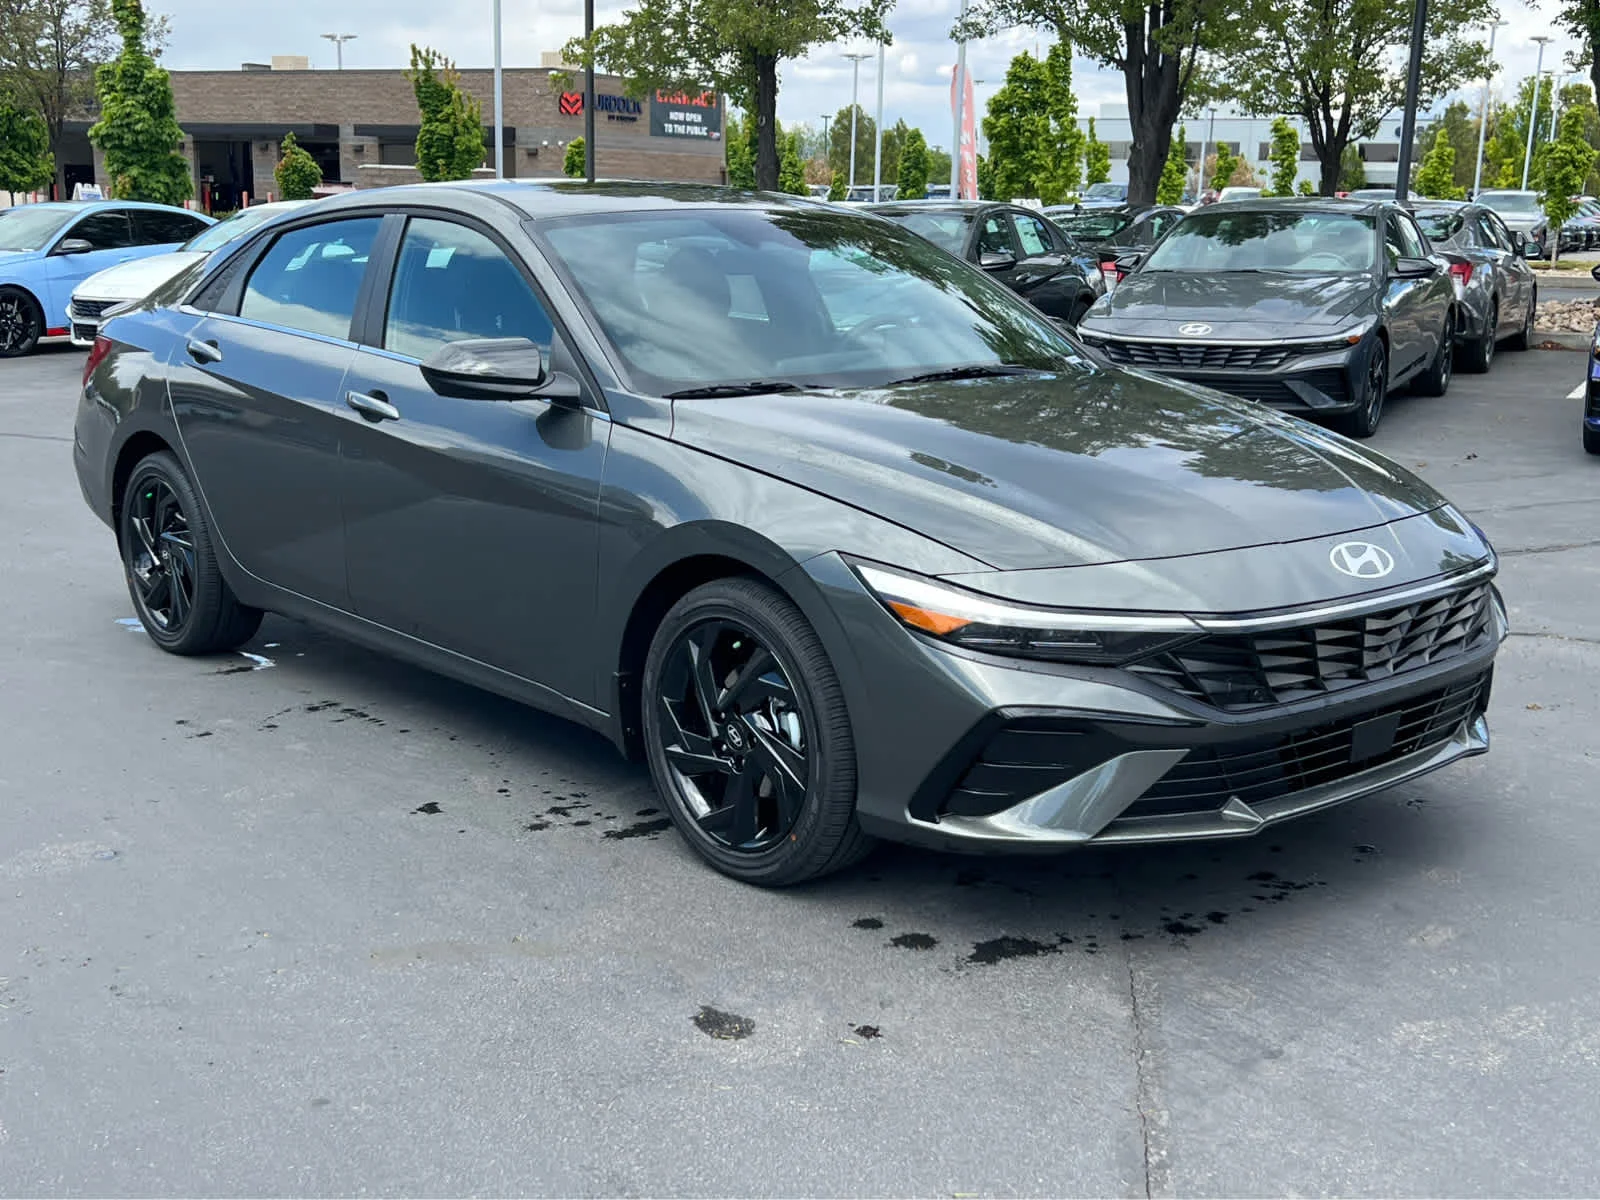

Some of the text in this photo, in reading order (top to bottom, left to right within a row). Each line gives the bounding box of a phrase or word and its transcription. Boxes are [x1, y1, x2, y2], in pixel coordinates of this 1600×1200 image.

[669, 111, 702, 123] NOW OPEN
[664, 123, 673, 133] TO
[673, 124, 686, 135] THE
[686, 125, 708, 136] PUBLIC
